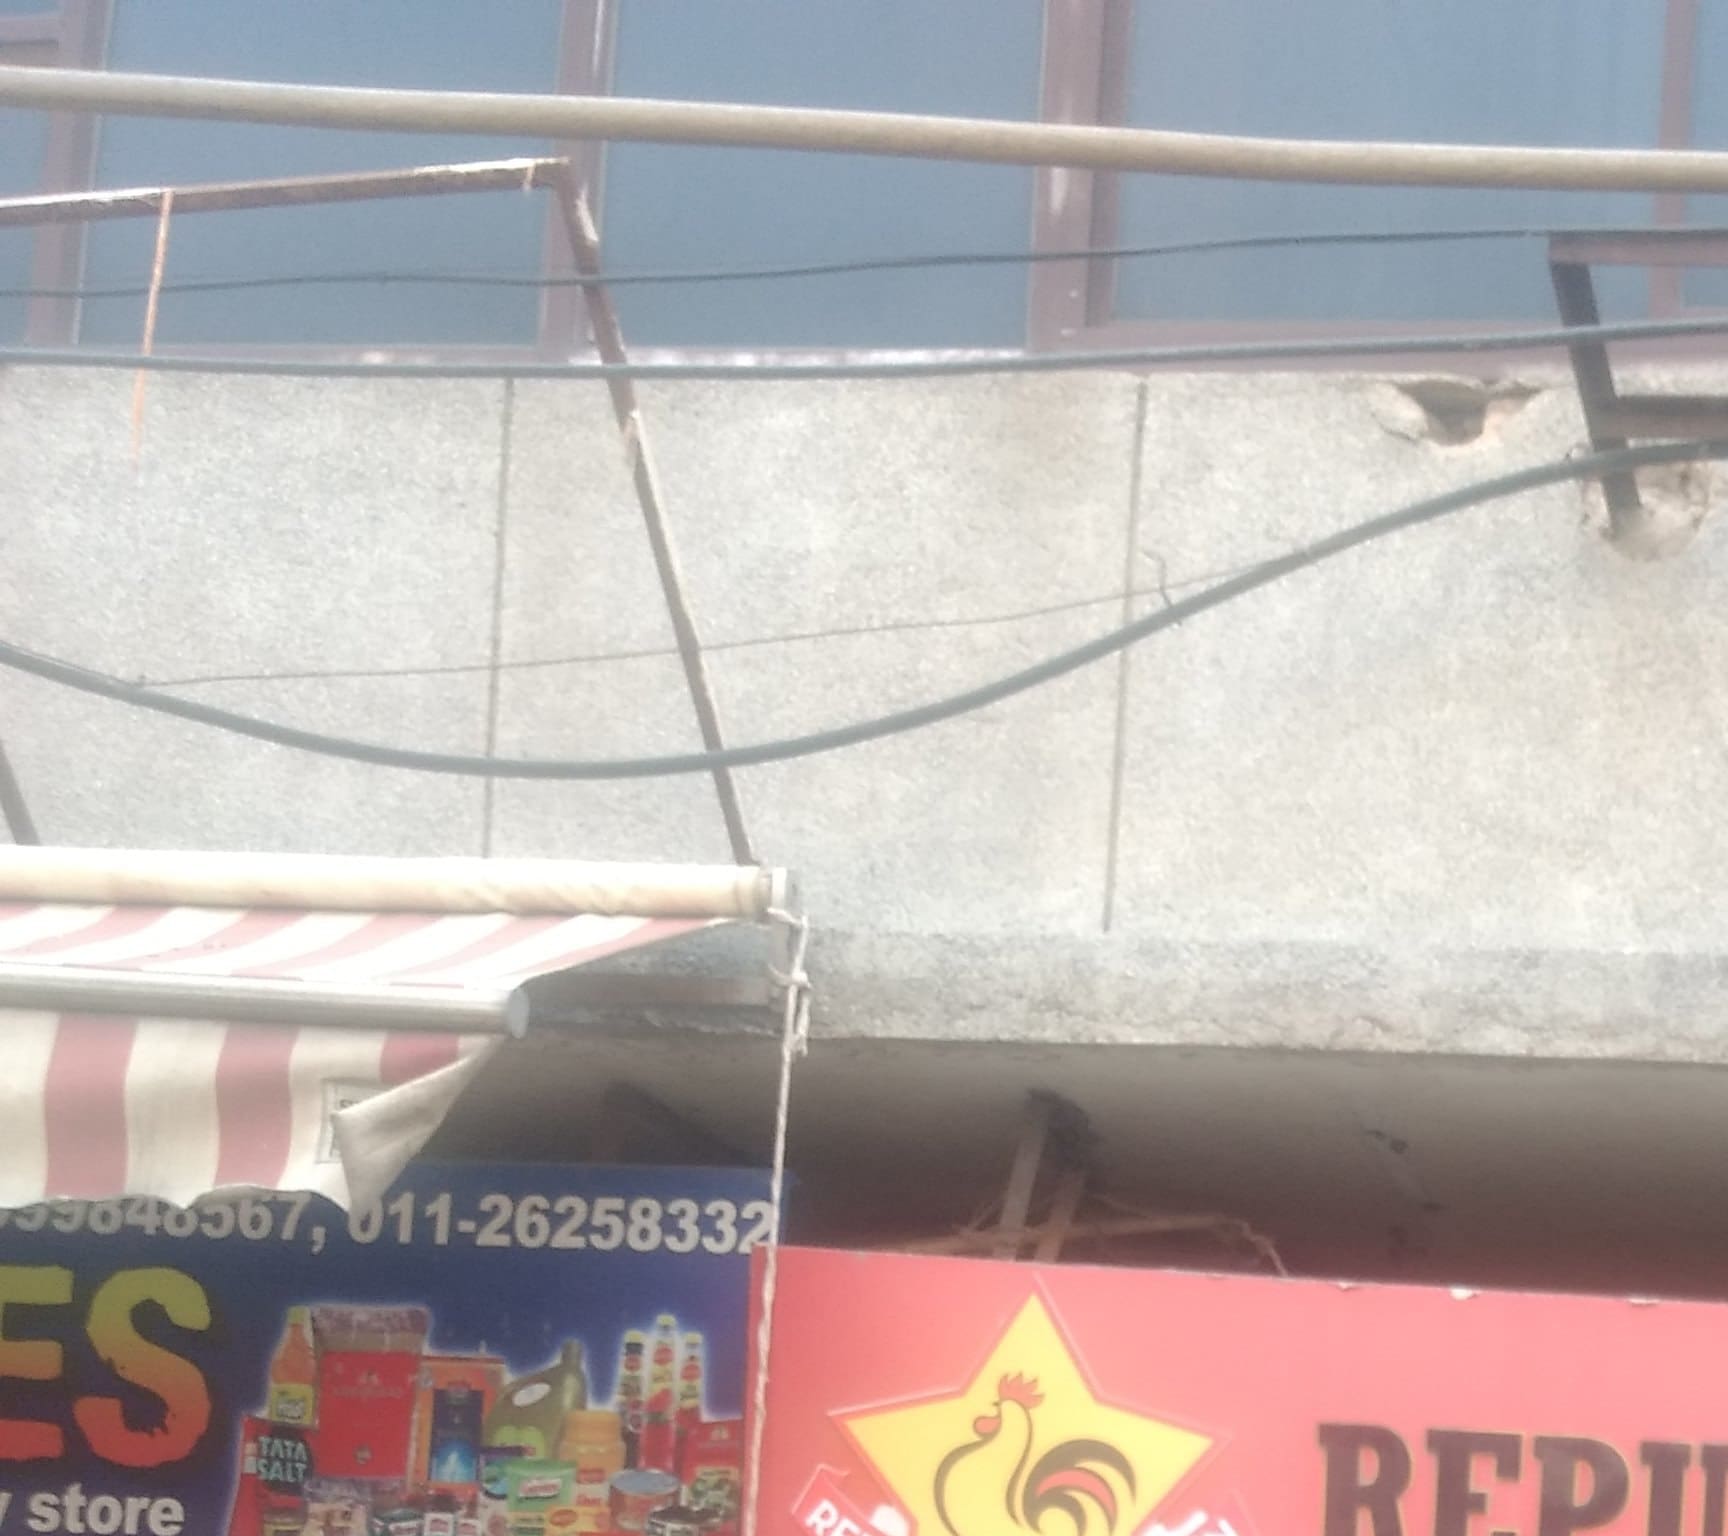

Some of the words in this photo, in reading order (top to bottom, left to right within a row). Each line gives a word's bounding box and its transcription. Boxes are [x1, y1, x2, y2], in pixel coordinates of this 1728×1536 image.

[347, 1190, 776, 1255] 011-26258332
[257, 1435, 308, 1458] TATA
[256, 1456, 307, 1483] SALT
